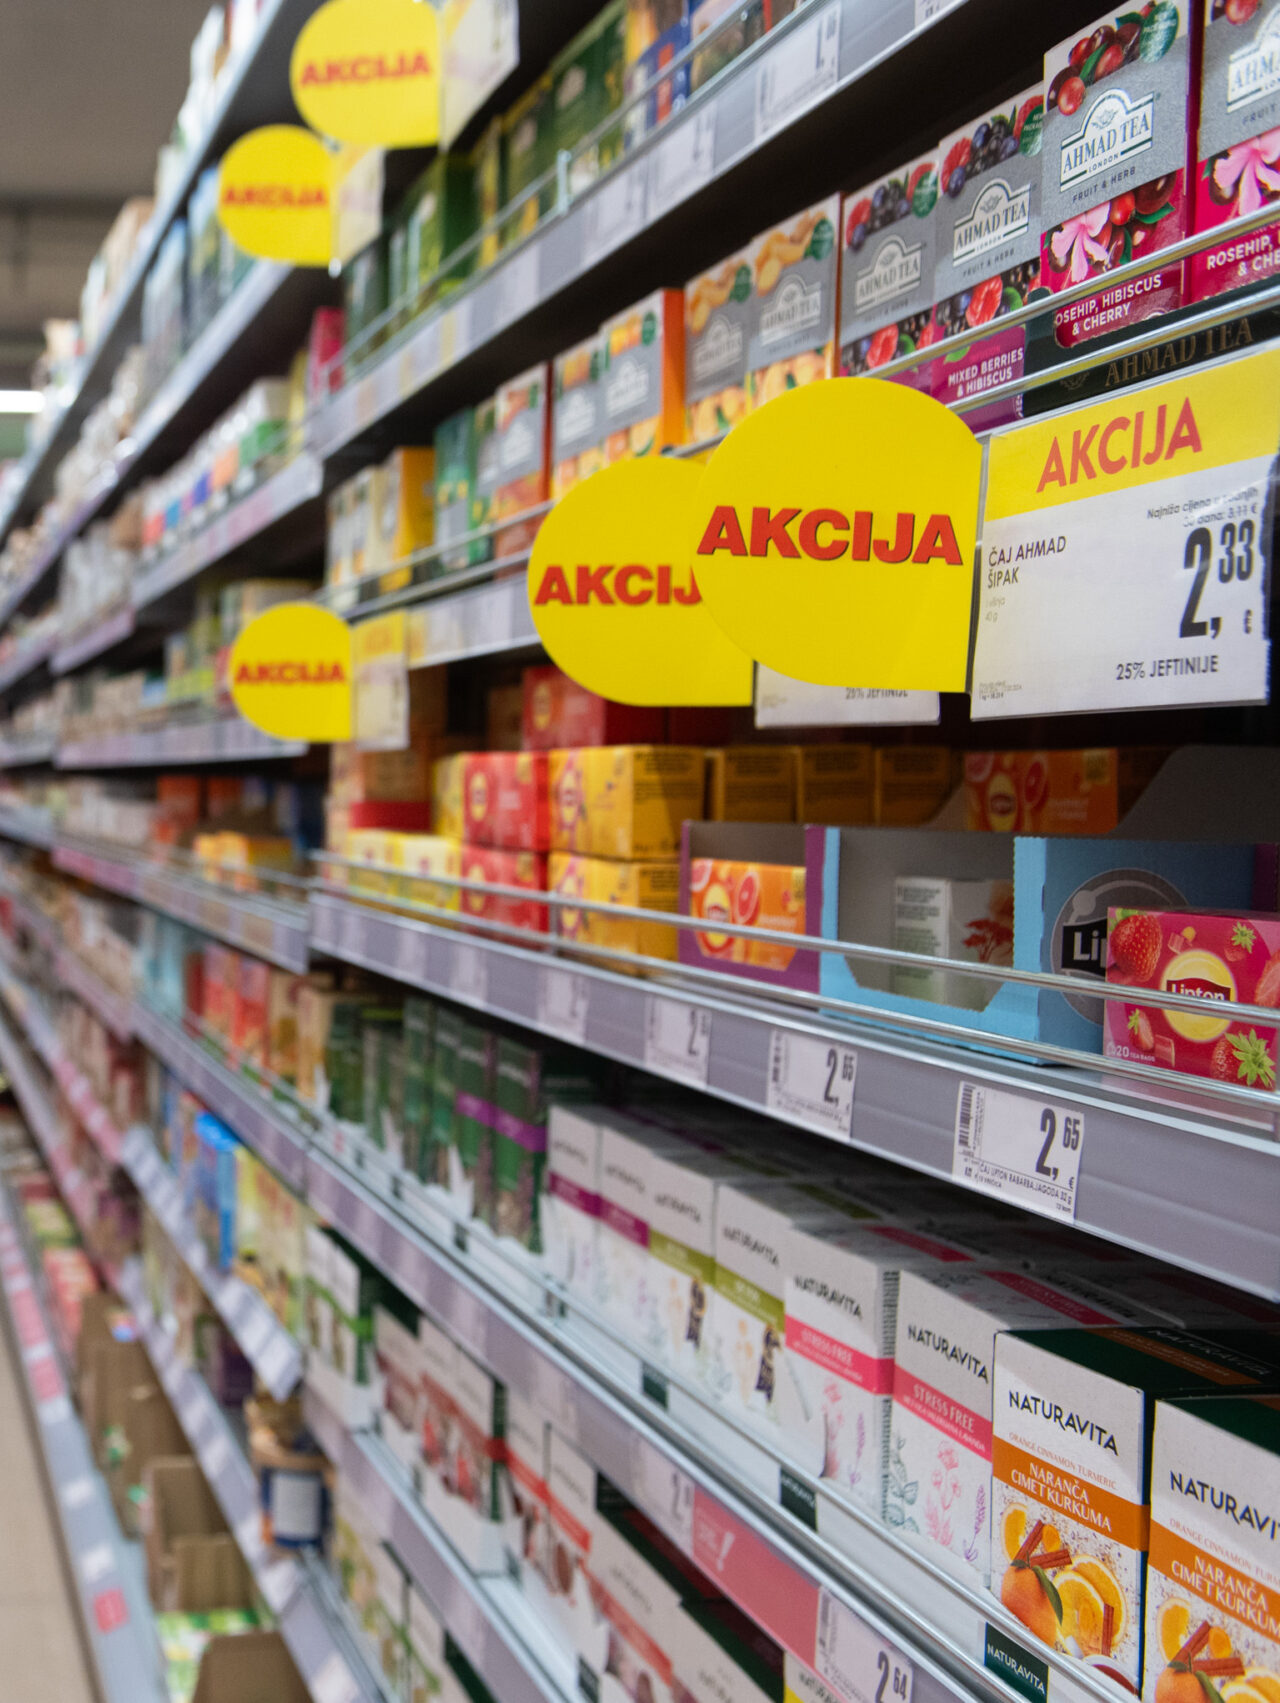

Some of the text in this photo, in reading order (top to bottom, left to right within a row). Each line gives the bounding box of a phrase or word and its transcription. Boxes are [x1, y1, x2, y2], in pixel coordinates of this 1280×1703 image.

[300, 51, 432, 87] AKCIJA
[1063, 111, 1150, 174] AHMAD TEA
[1088, 153, 1120, 172] LONDON
[1073, 184, 1099, 202] FRUIT
[1111, 166, 1136, 183] HERB
[956, 201, 1027, 252] AHMAD TEA
[1055, 274, 1162, 327] OSEHIP, HIBISCUS
[1072, 302, 1132, 336] & CHERRY
[948, 347, 1024, 387] MIXED BERRIES
[1105, 317, 1254, 387] AHMAD TEA
[966, 366, 1013, 394] HIBISCUS
[1035, 396, 1204, 494] AKCIJA
[697, 505, 964, 566] AKCIJA
[988, 535, 1067, 567] ČAJ AHMAD
[533, 564, 705, 606] AKCIJ
[987, 566, 1020, 589] ŠIPAK
[234, 661, 346, 685] AKCIJA
[1114, 655, 1219, 681] 25% JEFTINIJE
[1116, 1045, 1130, 1058] 20
[907, 1324, 990, 1385] NATURAVITA
[913, 1383, 949, 1417] STRESS
[949, 1406, 975, 1433] FREE
[1008, 1389, 1119, 1457] NATURAVITA
[1009, 1431, 1117, 1490] ORANGE CINNAMON TURMERIC
[1011, 1469, 1113, 1532] CIMET KURKUMA
[1029, 1462, 1090, 1505] NARANČA
[1170, 1470, 1280, 1540] NATURAVI
[1171, 1559, 1214, 1597] CIMET
[1195, 1554, 1269, 1612] NARANČA
[987, 1645, 1047, 1692] NATURAVITA
